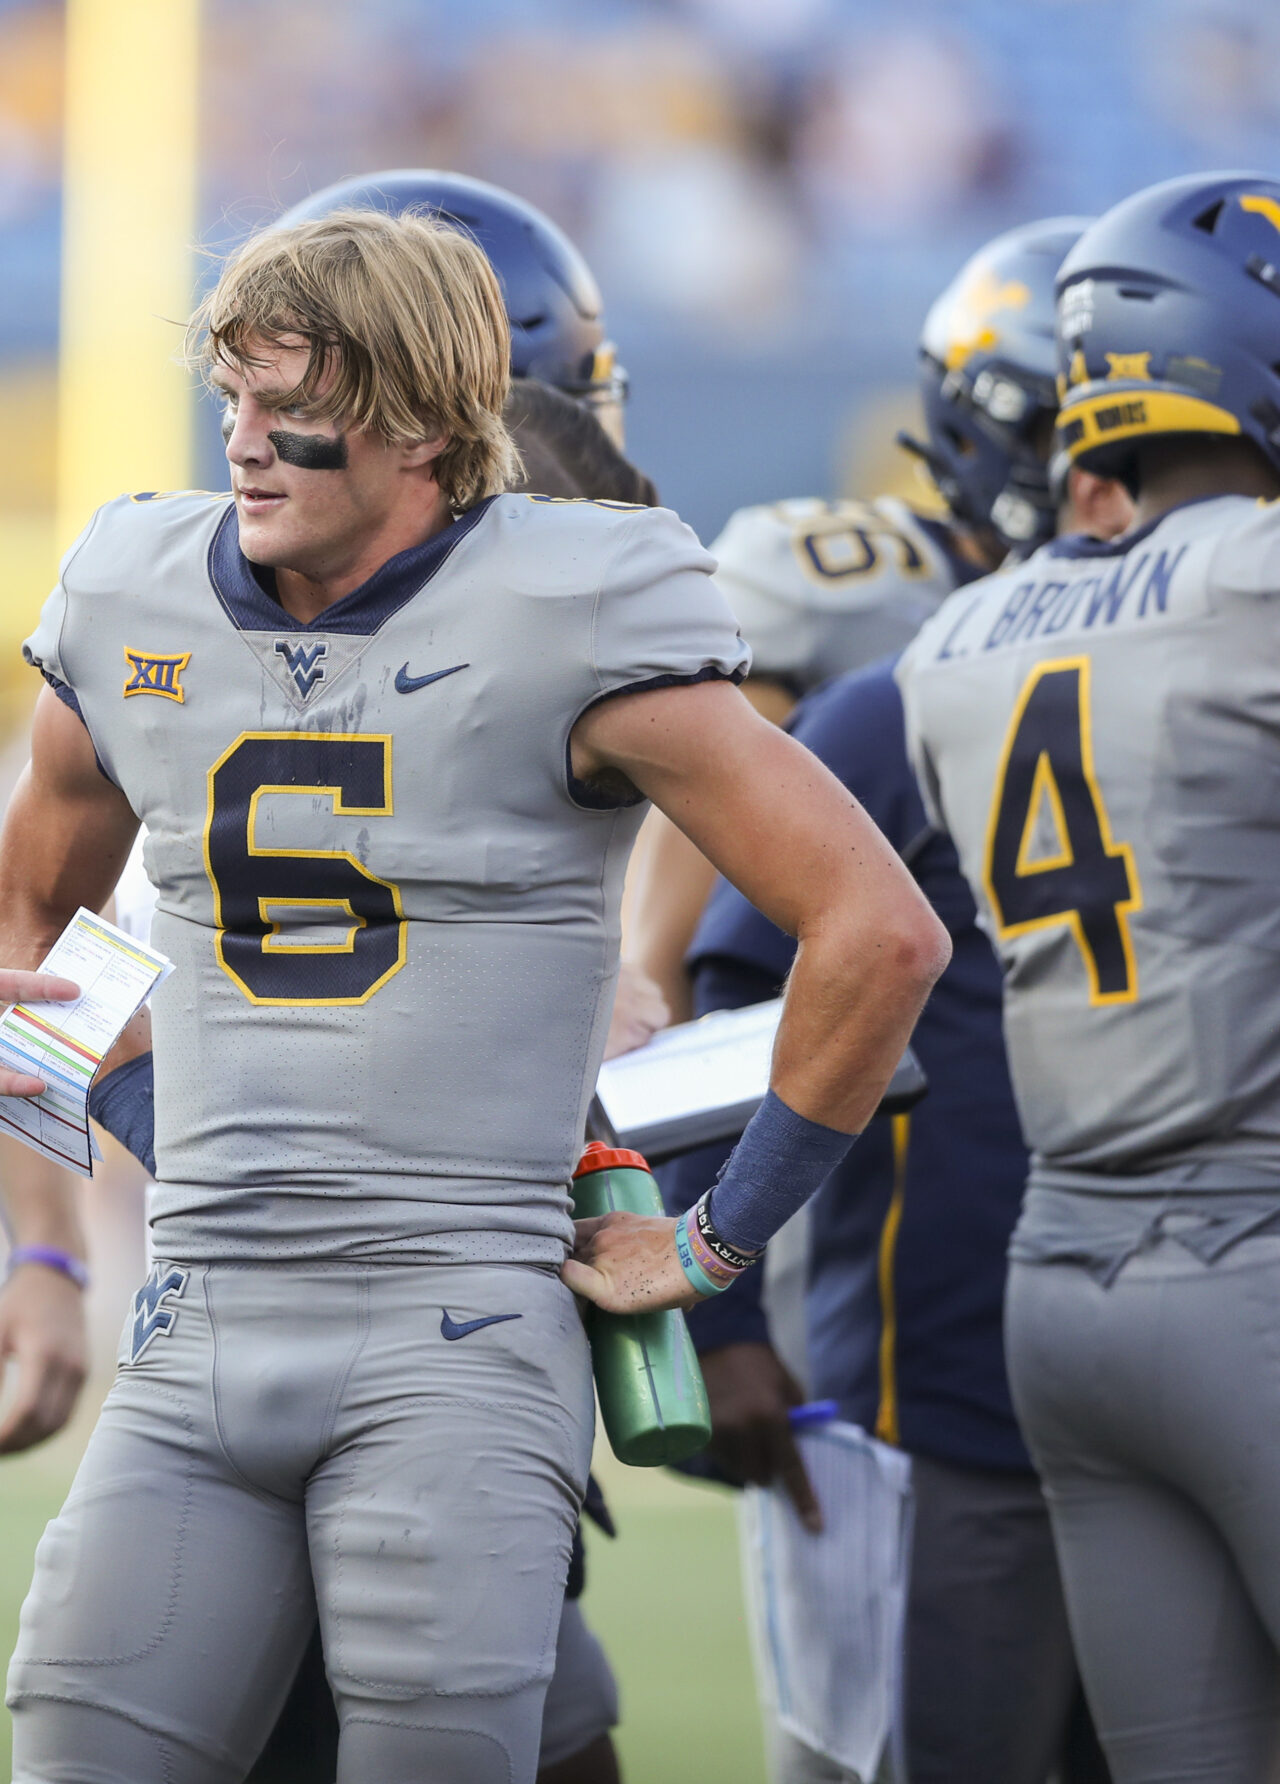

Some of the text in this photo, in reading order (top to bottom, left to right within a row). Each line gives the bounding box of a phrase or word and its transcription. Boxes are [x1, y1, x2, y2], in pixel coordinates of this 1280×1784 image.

[984, 542, 1188, 651] BROWN
[202, 730, 408, 1006] 6
[981, 653, 1143, 1007] 4
[677, 1242, 693, 1268] SET
